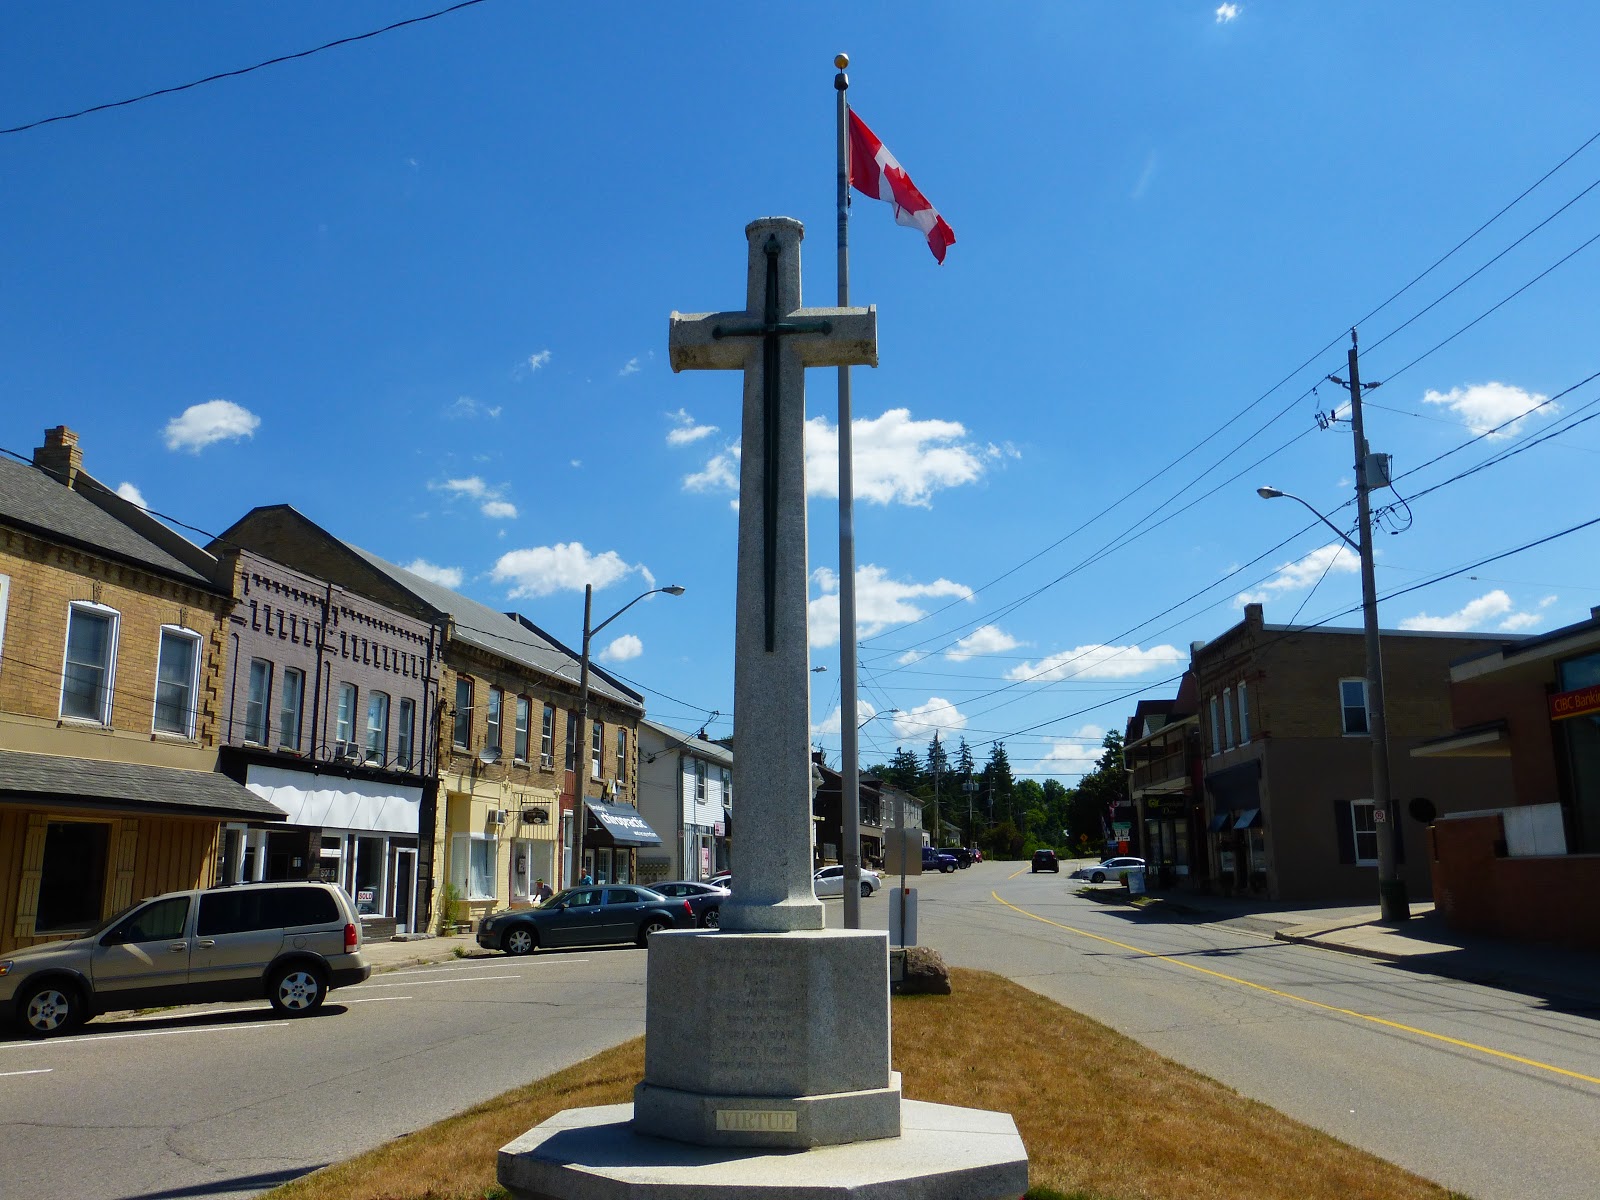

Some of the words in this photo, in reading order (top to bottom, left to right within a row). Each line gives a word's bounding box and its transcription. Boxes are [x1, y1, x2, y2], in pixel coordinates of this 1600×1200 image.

[1554, 696, 1575, 712] CIBC
[600, 811, 647, 829] chiropractic
[359, 892, 373, 900] SOLD
[720, 1112, 793, 1130] VIRTUE
